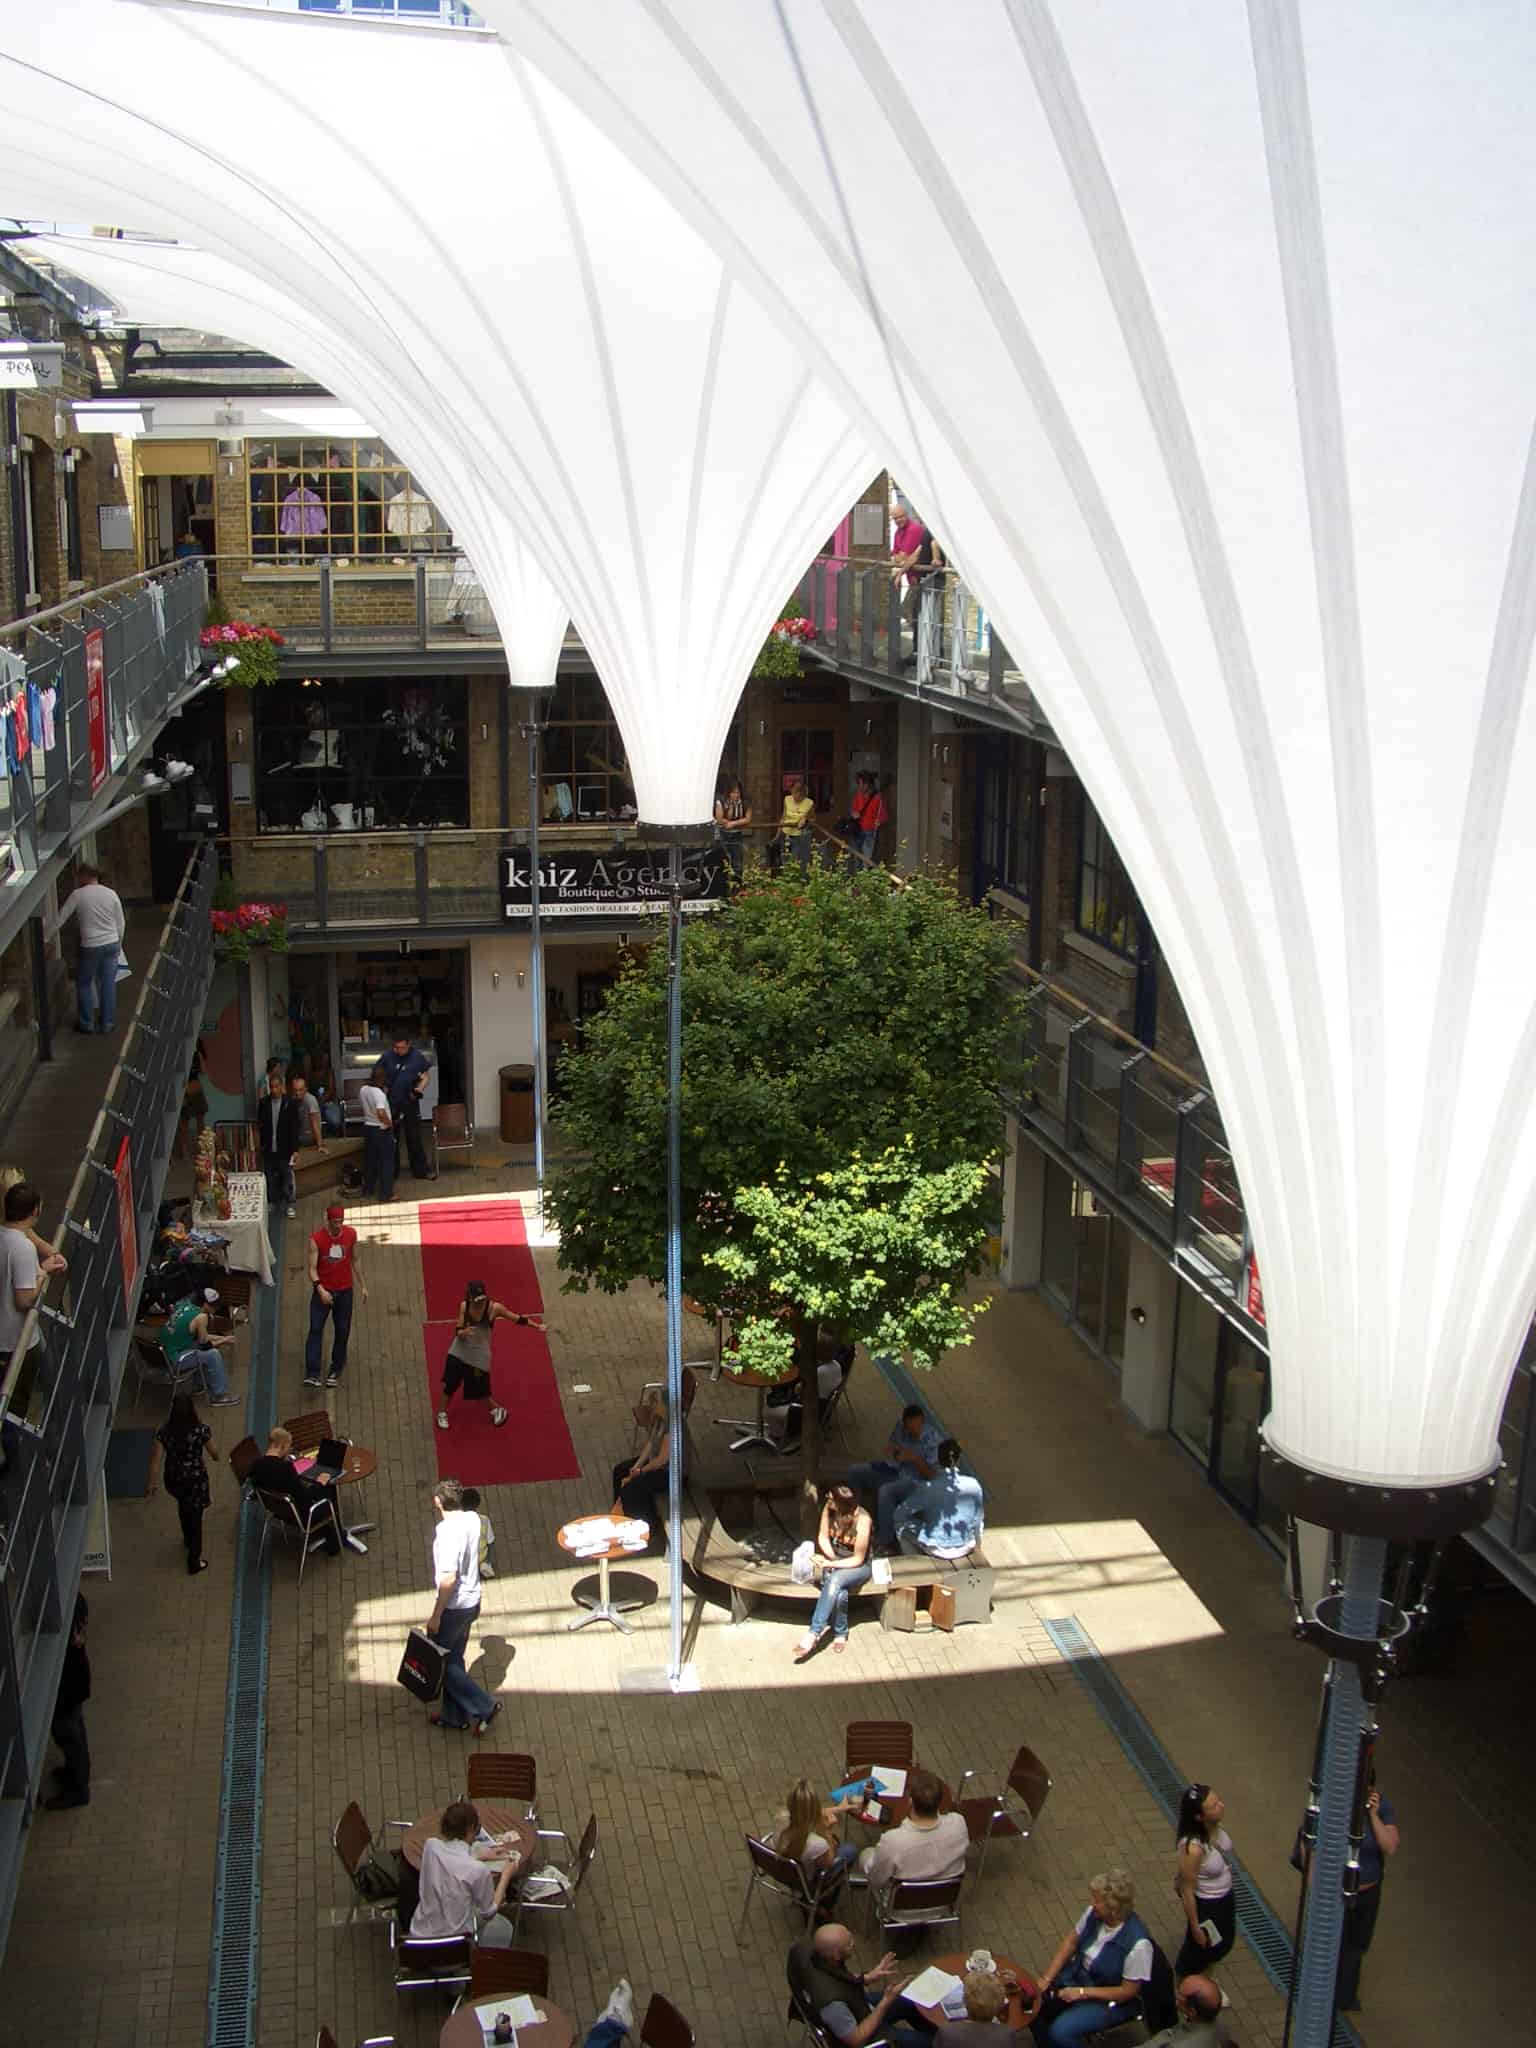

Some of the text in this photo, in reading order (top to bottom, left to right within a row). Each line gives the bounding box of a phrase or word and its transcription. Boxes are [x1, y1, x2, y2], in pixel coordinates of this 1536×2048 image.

[585, 859, 720, 899] Agency
[559, 887, 615, 901] Boutique
[510, 905, 558, 914] EXCLSIVE
